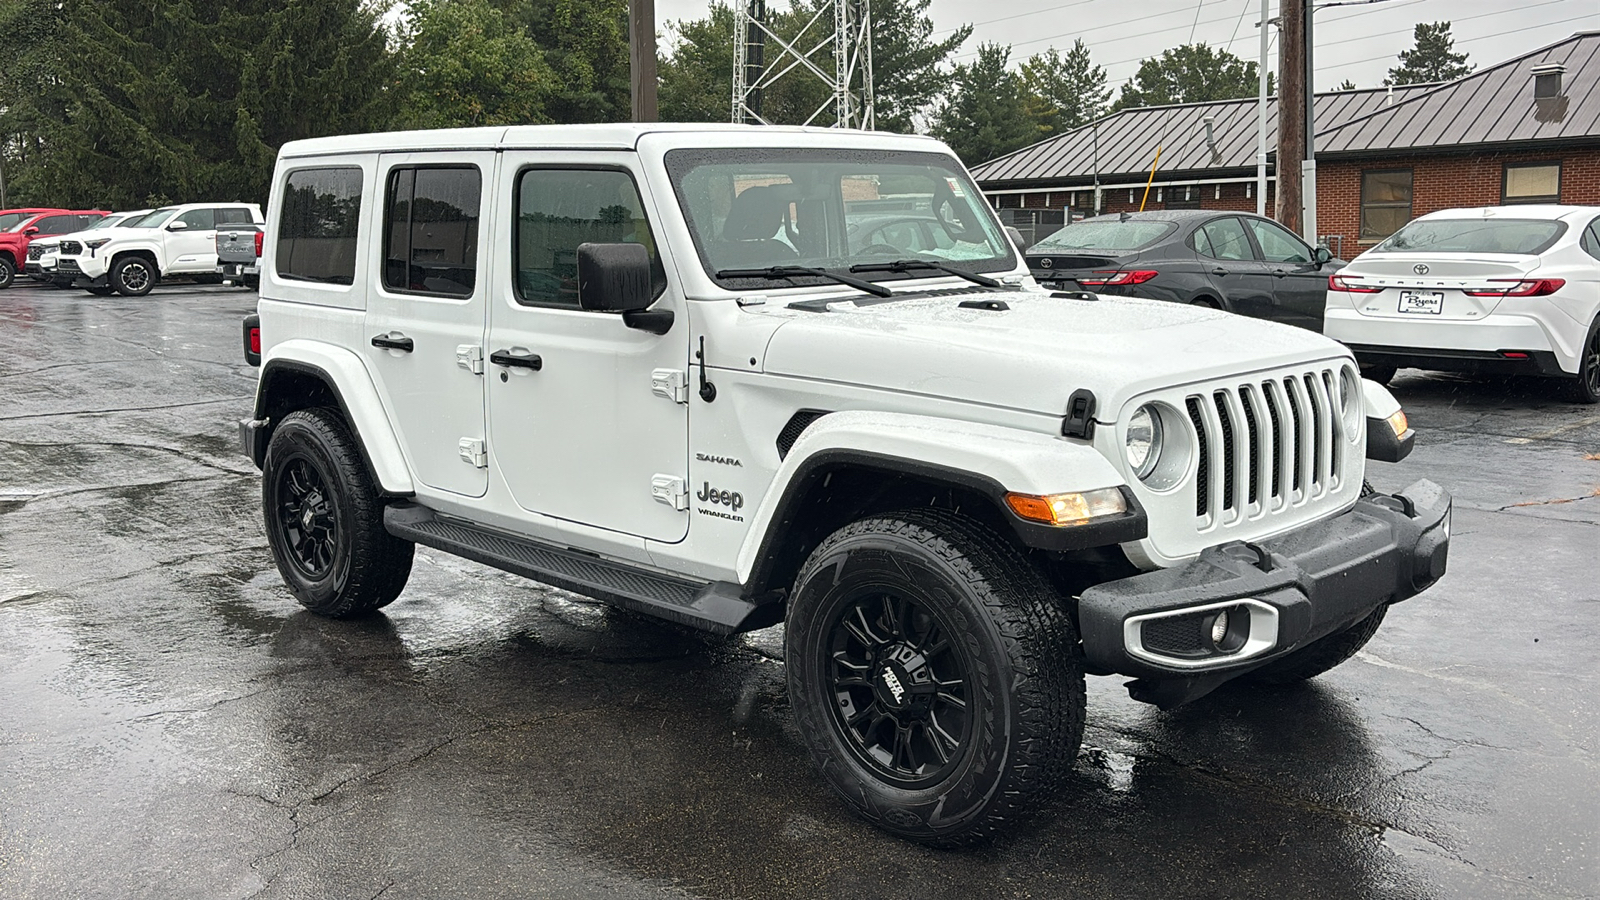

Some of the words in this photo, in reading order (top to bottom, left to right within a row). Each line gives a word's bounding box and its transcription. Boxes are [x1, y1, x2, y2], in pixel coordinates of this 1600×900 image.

[1405, 296, 1437, 307] Byers
[697, 454, 743, 467] SAHARA
[697, 481, 744, 512] Jeep
[698, 508, 744, 522] WRANGLER
[882, 673, 903, 704] METAL
[884, 666, 905, 693] MOTO
